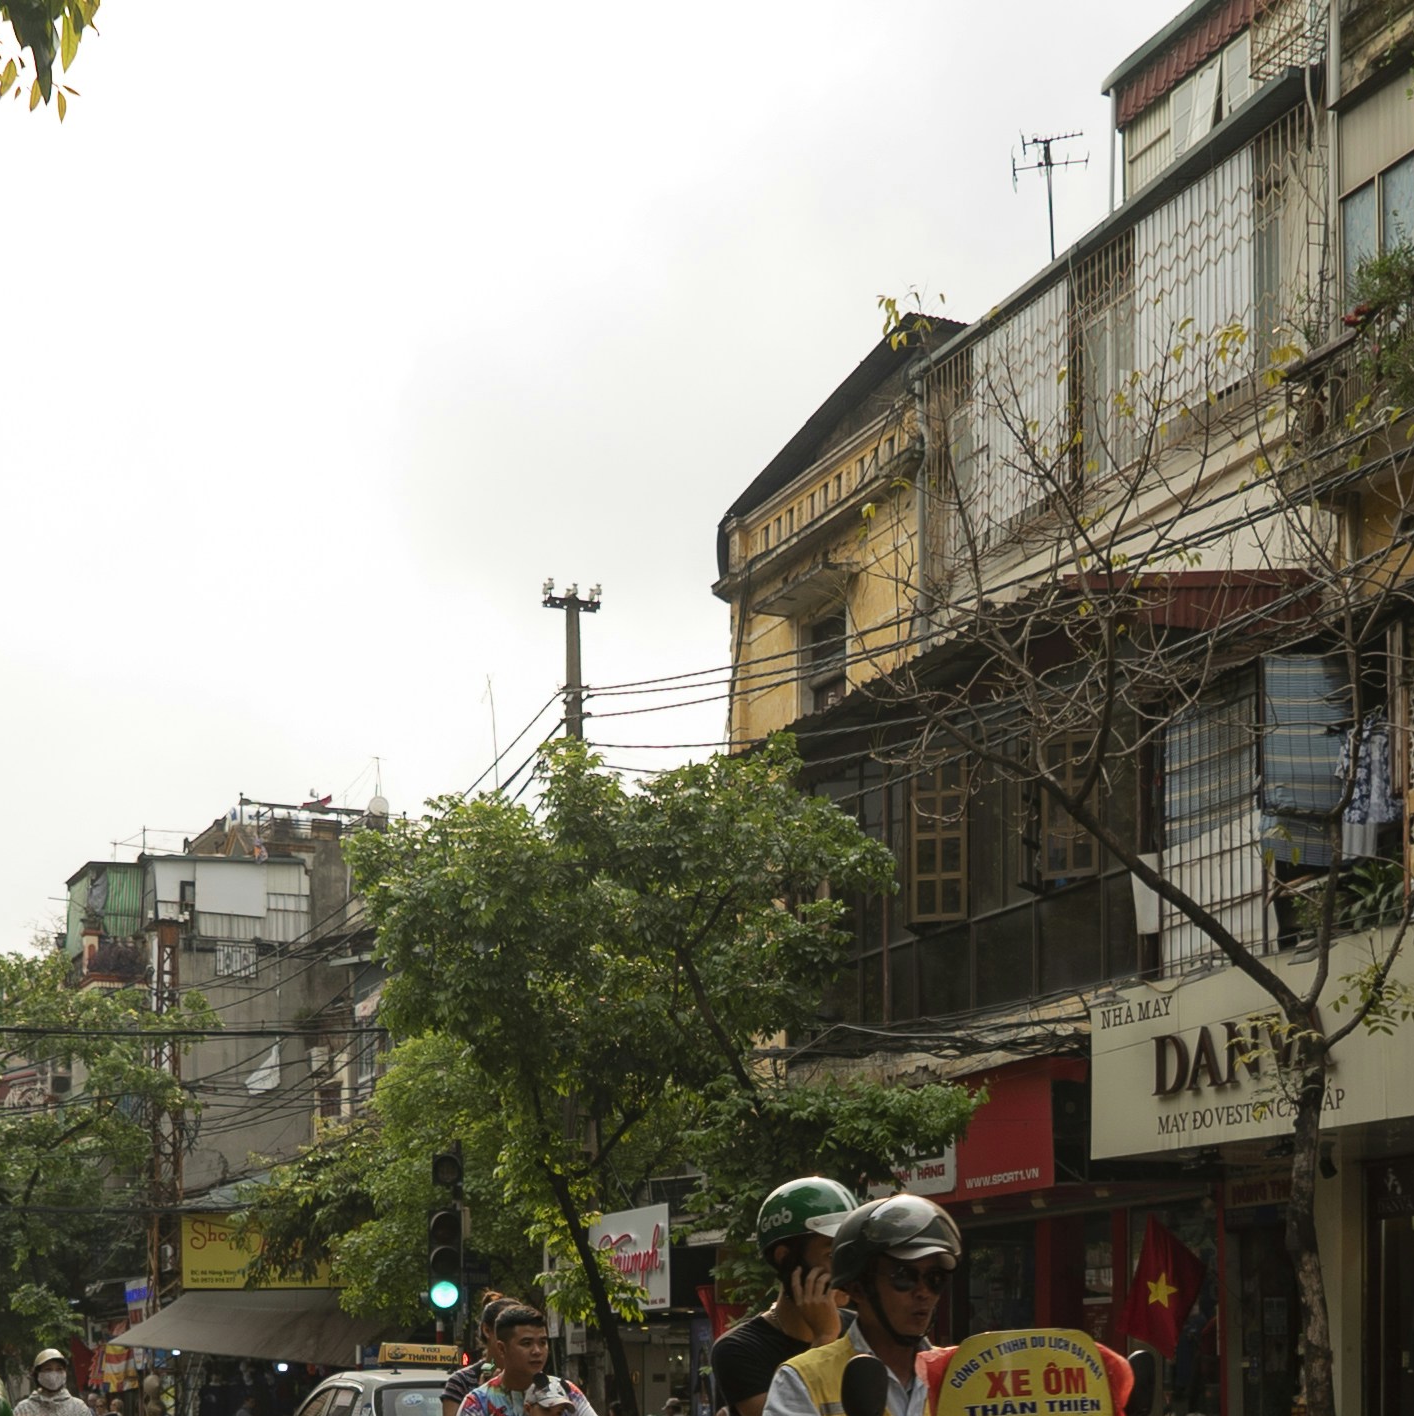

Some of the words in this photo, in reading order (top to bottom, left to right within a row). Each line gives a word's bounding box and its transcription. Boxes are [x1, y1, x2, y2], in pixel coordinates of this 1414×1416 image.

[1137, 995, 1173, 1022] MAY
[1157, 1112, 1189, 1135] MAY
[965, 1166, 1040, 1190] WWW.SPORT1.VN
[760, 1206, 793, 1233] Grab
[949, 1358, 981, 1389] CÔNG
[981, 1350, 995, 1364] TY
[995, 1337, 1028, 1356] TNHH
[1030, 1336, 1046, 1349] DU
[1049, 1335, 1070, 1353] LỊCH
[985, 1368, 1032, 1399] XE
[1043, 1361, 1087, 1395] ÔM
[1045, 1398, 1101, 1415] THIỆN
